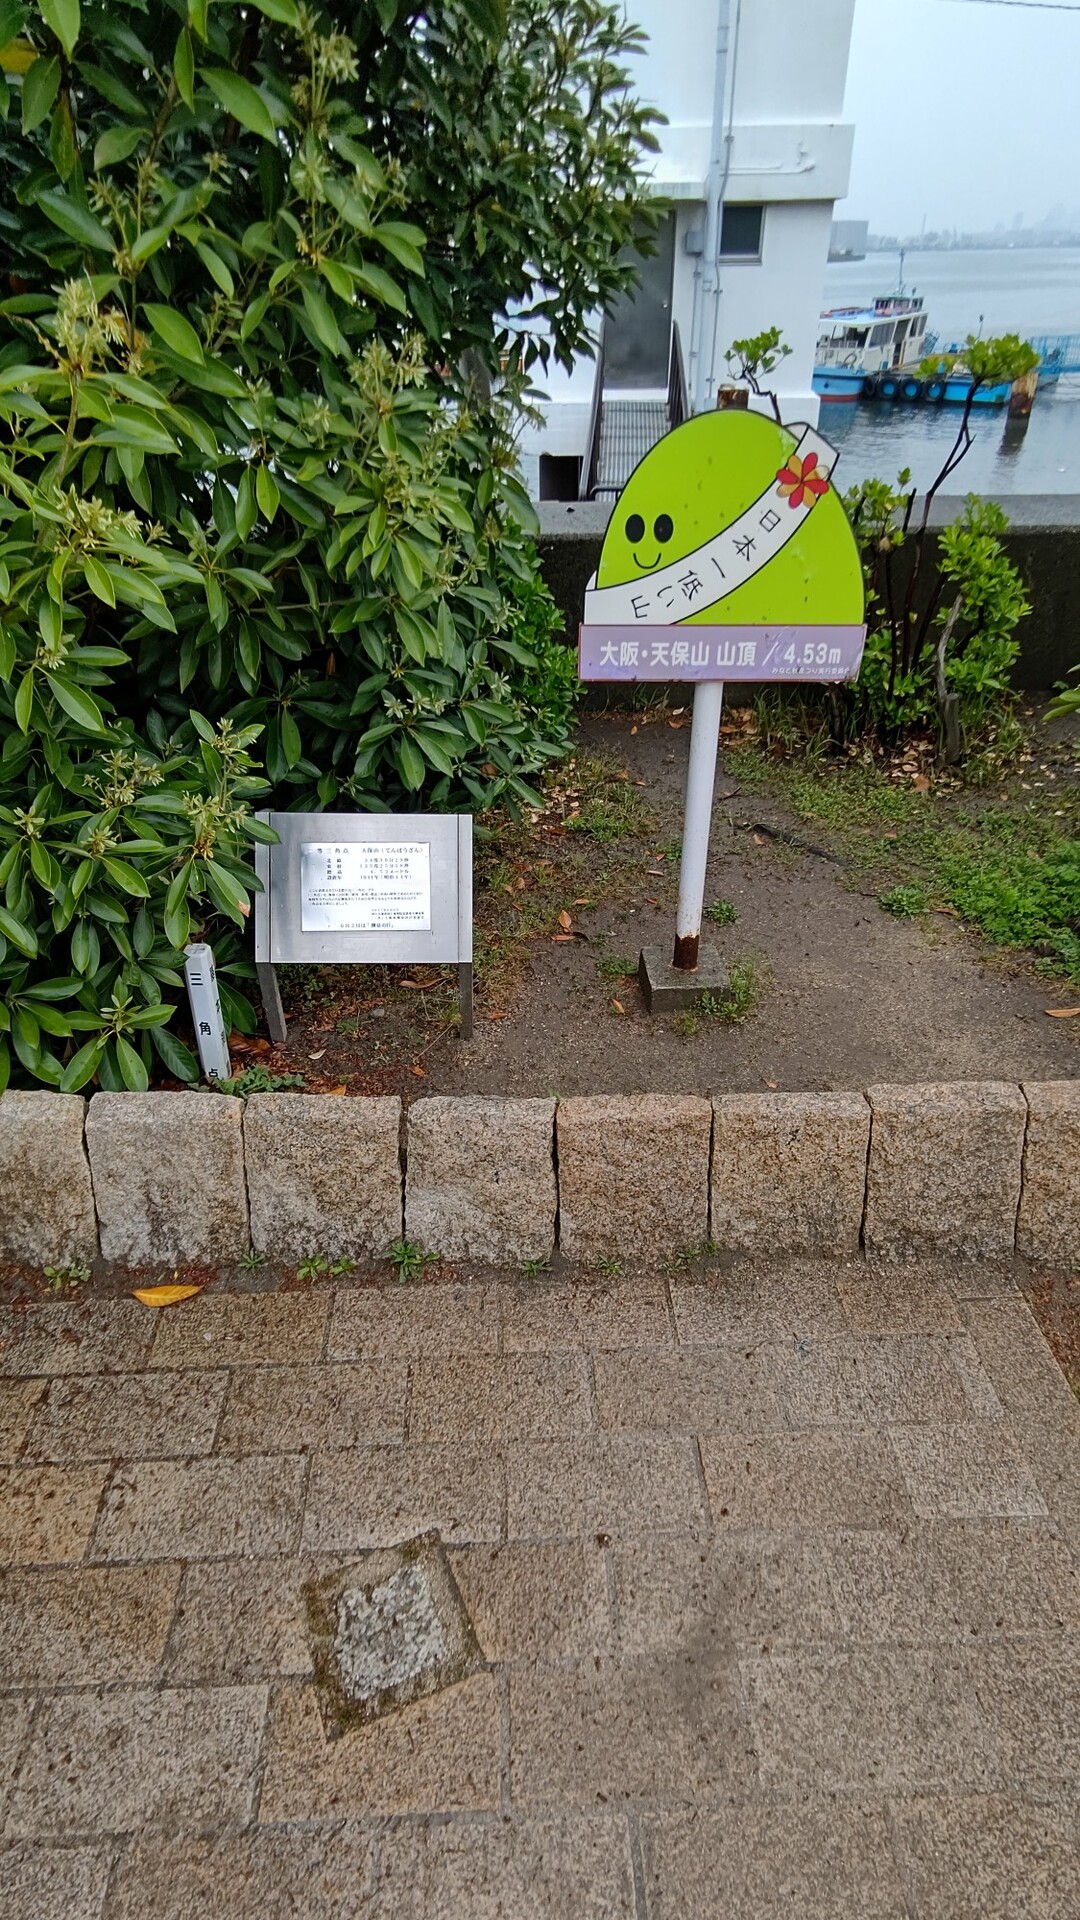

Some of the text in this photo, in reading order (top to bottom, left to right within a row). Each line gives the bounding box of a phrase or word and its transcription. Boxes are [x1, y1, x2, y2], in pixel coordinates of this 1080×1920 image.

[630, 508, 782, 619] 日本一低い山
[599, 640, 710, 667] 大阪・天保山
[716, 640, 758, 667] 山頂
[782, 642, 842, 665] 4.53m
